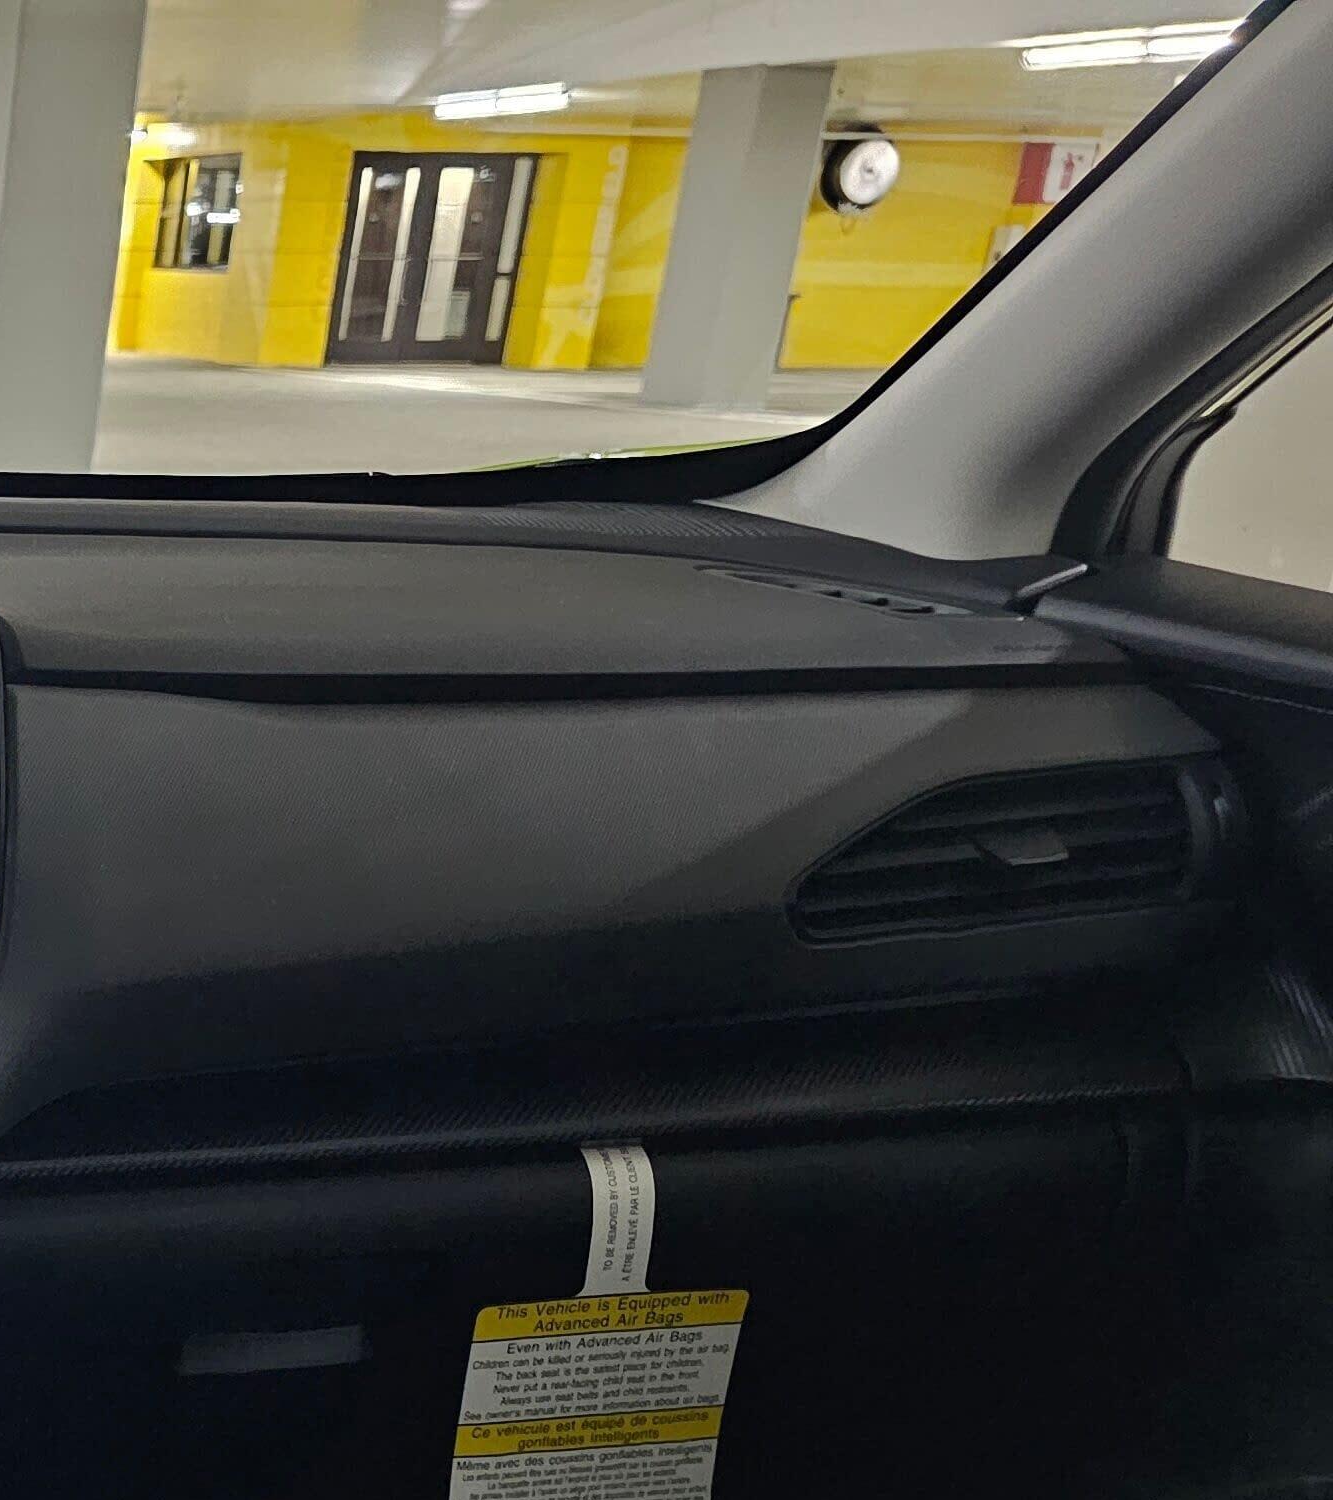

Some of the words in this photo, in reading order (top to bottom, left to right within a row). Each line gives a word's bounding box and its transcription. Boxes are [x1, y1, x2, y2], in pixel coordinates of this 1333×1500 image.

[497, 1306, 528, 1320] This
[536, 1301, 591, 1316] Vehicle
[597, 1298, 610, 1311] is
[617, 1293, 692, 1313] Equipped
[698, 1292, 730, 1305] with
[533, 1314, 610, 1333] Advanced
[615, 1313, 638, 1327] Air
[644, 1311, 684, 1328] Bags
[506, 1342, 540, 1355] Even
[545, 1340, 571, 1352] with
[577, 1333, 641, 1349] Advanced
[645, 1332, 664, 1345] Air
[670, 1331, 703, 1344] Bags
[471, 1427, 491, 1439] Ce
[555, 1421, 576, 1433] est
[630, 1415, 648, 1427] de
[651, 1411, 710, 1426] coussins
[517, 1433, 585, 1452] gonflables
[590, 1429, 660, 1446] intelligents
[494, 1459, 521, 1470] avec
[524, 1456, 545, 1467] des
[548, 1453, 595, 1466] coussins
